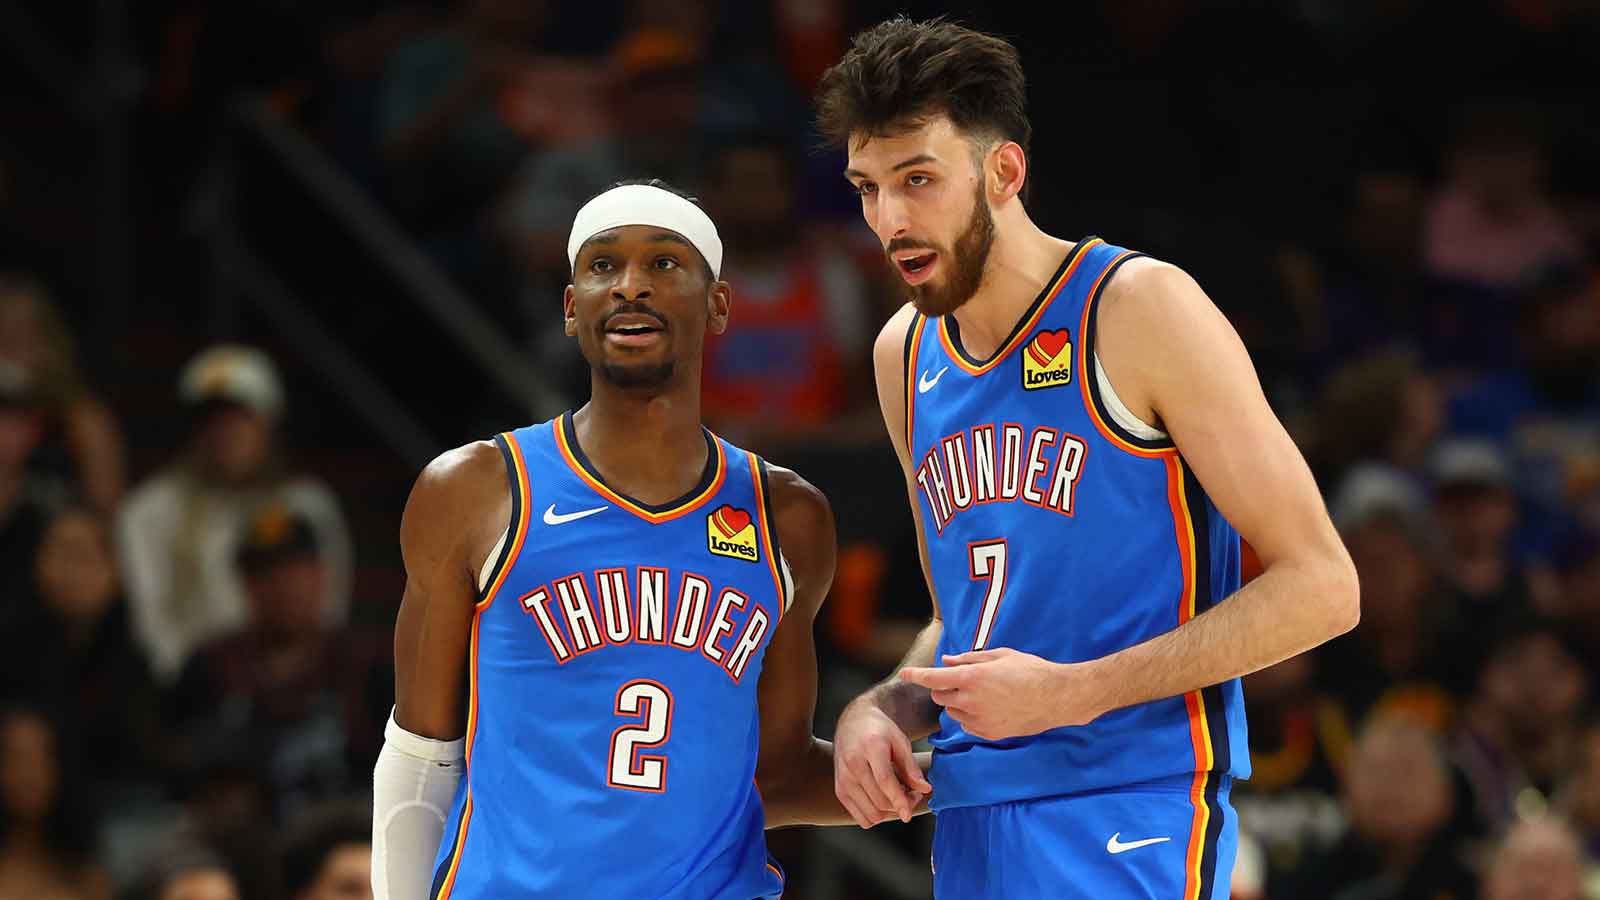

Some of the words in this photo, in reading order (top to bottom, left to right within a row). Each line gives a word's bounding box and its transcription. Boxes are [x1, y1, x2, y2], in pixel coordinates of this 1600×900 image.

[916, 422, 1089, 537] THUNDER
[519, 566, 770, 685] THUNDER
[968, 538, 1008, 651] 7
[607, 678, 673, 793] 2
